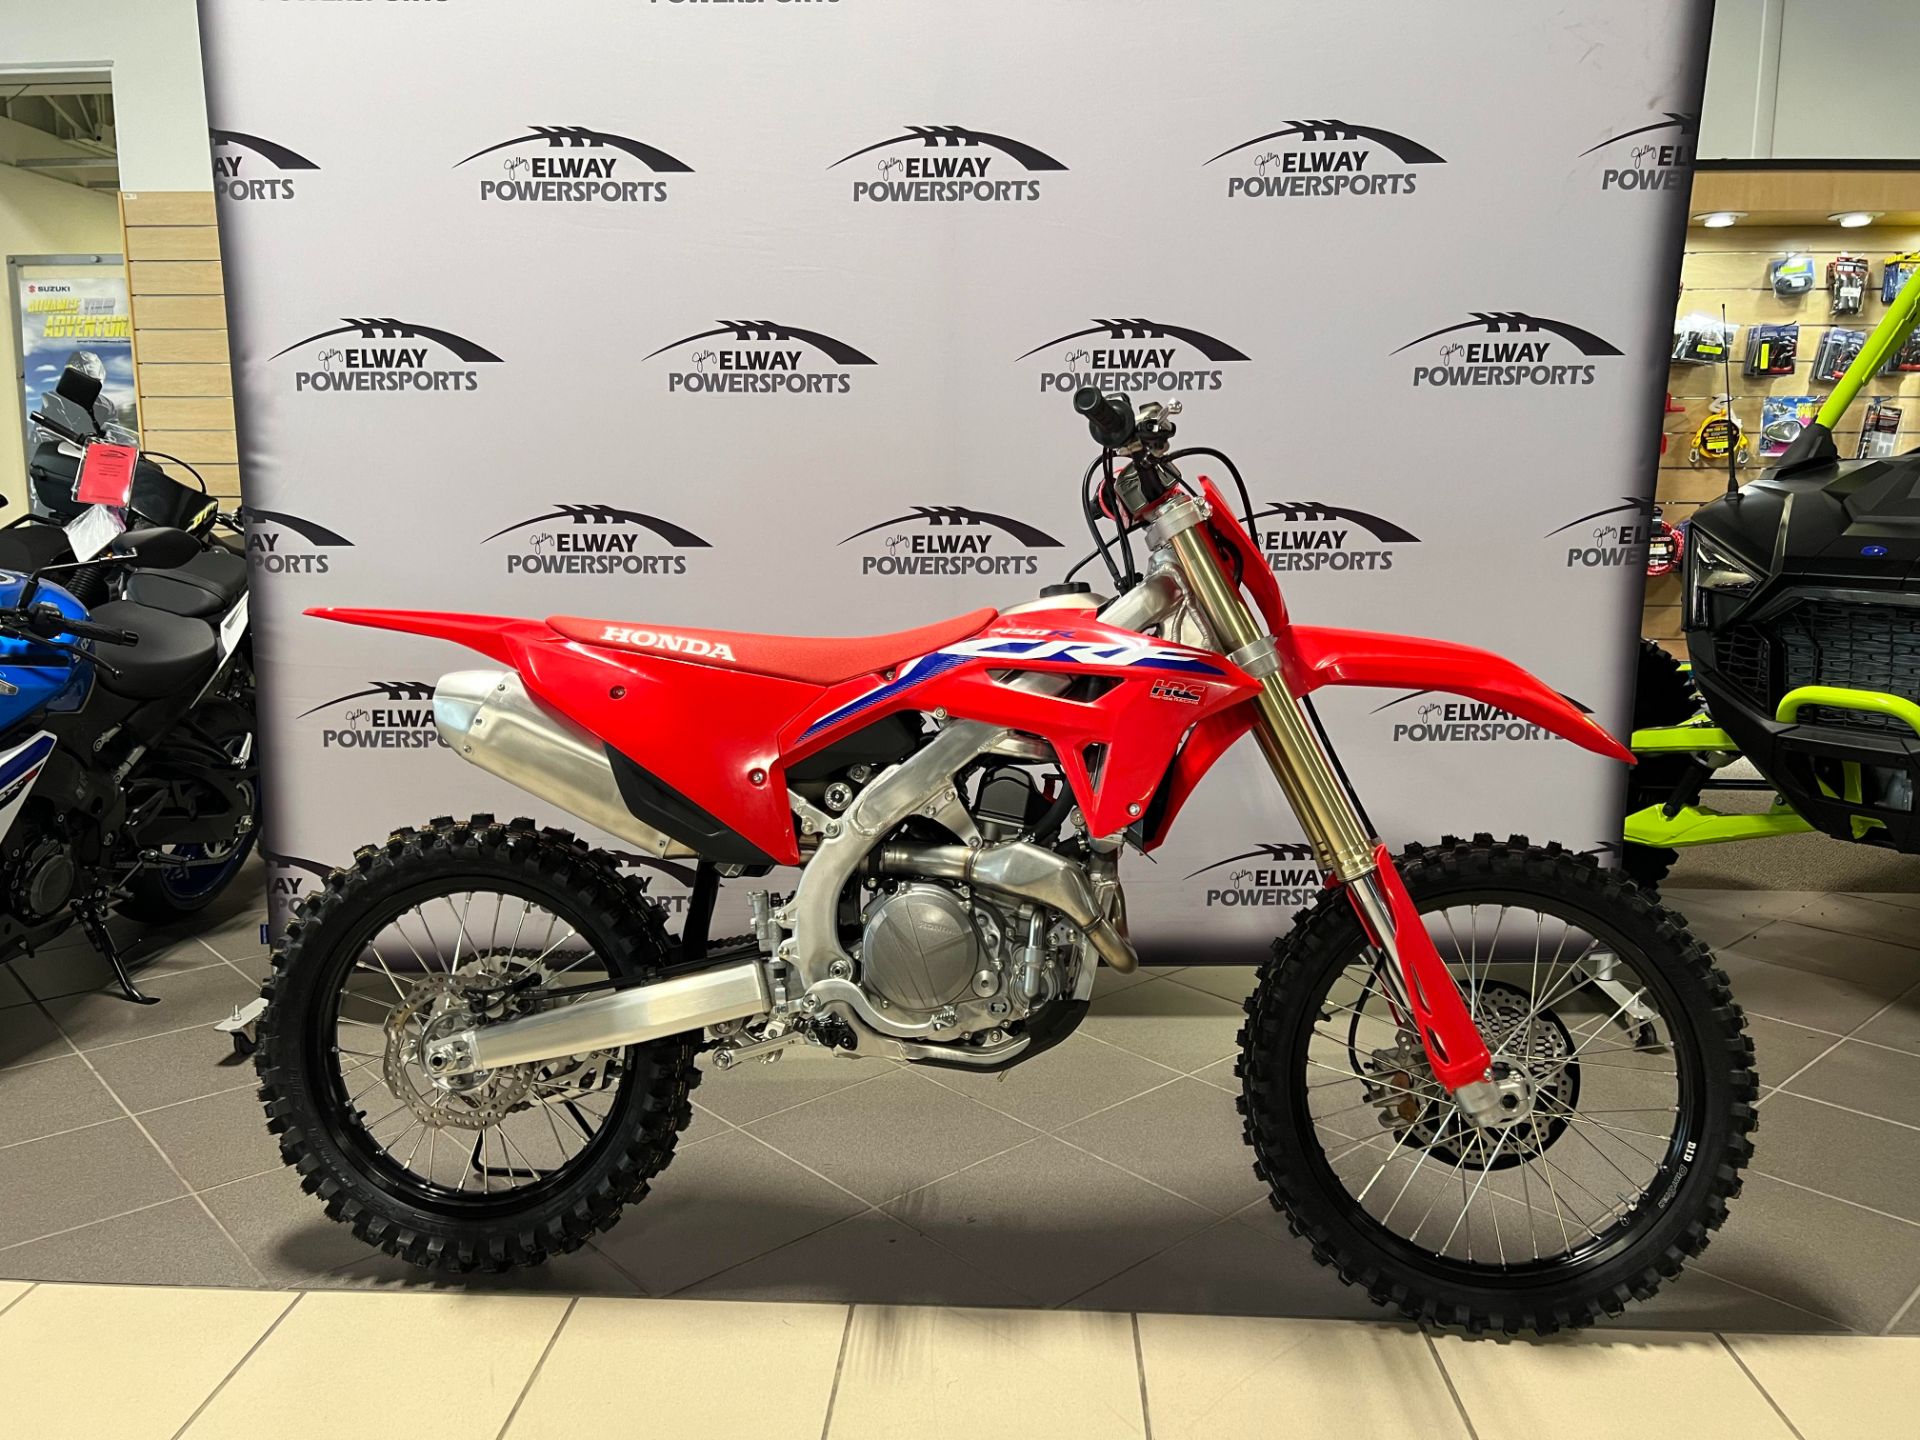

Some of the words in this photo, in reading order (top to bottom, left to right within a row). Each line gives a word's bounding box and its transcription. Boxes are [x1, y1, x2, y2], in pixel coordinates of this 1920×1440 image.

[531, 158, 617, 178] ELWAY
[905, 157, 991, 178] ELWAY
[1282, 151, 1369, 173] ELWAY
[480, 181, 668, 202] POWERSPORTS
[853, 180, 1040, 202] POWERSPORTS
[1228, 173, 1417, 198] POWERSPORTS
[345, 349, 428, 368] ELWAY
[719, 351, 803, 370] ELWAY
[1092, 349, 1176, 369] ELWAY
[1466, 342, 1550, 363] ELWAY
[296, 371, 478, 392] POWERSPORTS
[669, 373, 851, 393] POWERSPORTS
[1413, 365, 1596, 387] POWERSPORTS
[557, 533, 639, 552] ELWAY
[911, 535, 992, 554] ELWAY
[1265, 530, 1348, 550] ELWAY
[507, 555, 686, 574] POWERSPORTS
[862, 556, 1038, 575] POWERSPORTS
[600, 626, 737, 662] HONDA
[937, 637, 1213, 666] CRF
[1150, 679, 1206, 702] HRC
[372, 709, 437, 728] ELWA
